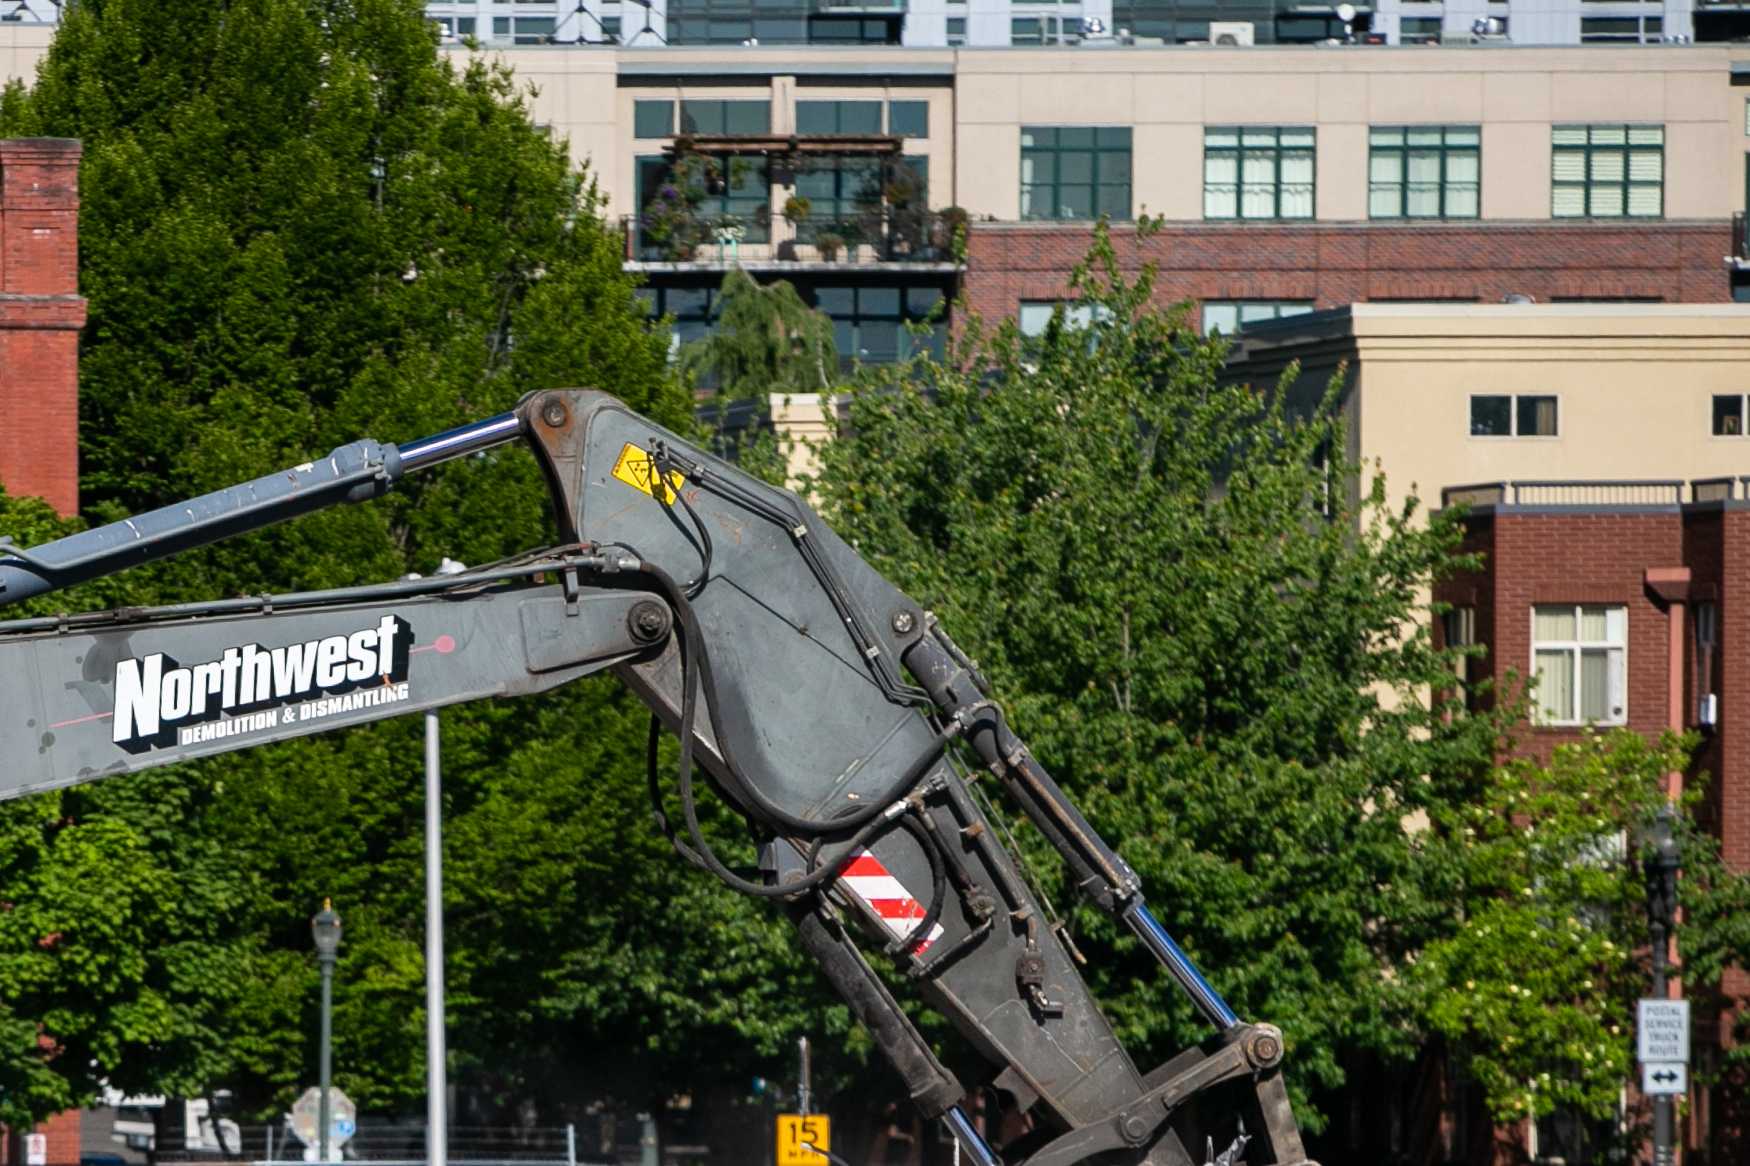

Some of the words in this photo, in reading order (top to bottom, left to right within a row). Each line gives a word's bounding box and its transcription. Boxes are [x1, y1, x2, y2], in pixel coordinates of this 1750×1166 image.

[113, 613, 400, 743] Northwest
[181, 710, 277, 746] DEMOLITION
[282, 707, 296, 724] &
[300, 683, 409, 721] DISMANTLING
[1645, 1004, 1681, 1017] POSTAL
[1644, 1018, 1683, 1030] SERVICE
[1648, 1030, 1679, 1042] TRUCK
[1648, 1043, 1679, 1057] ROUTE
[790, 1122, 819, 1146] 15
